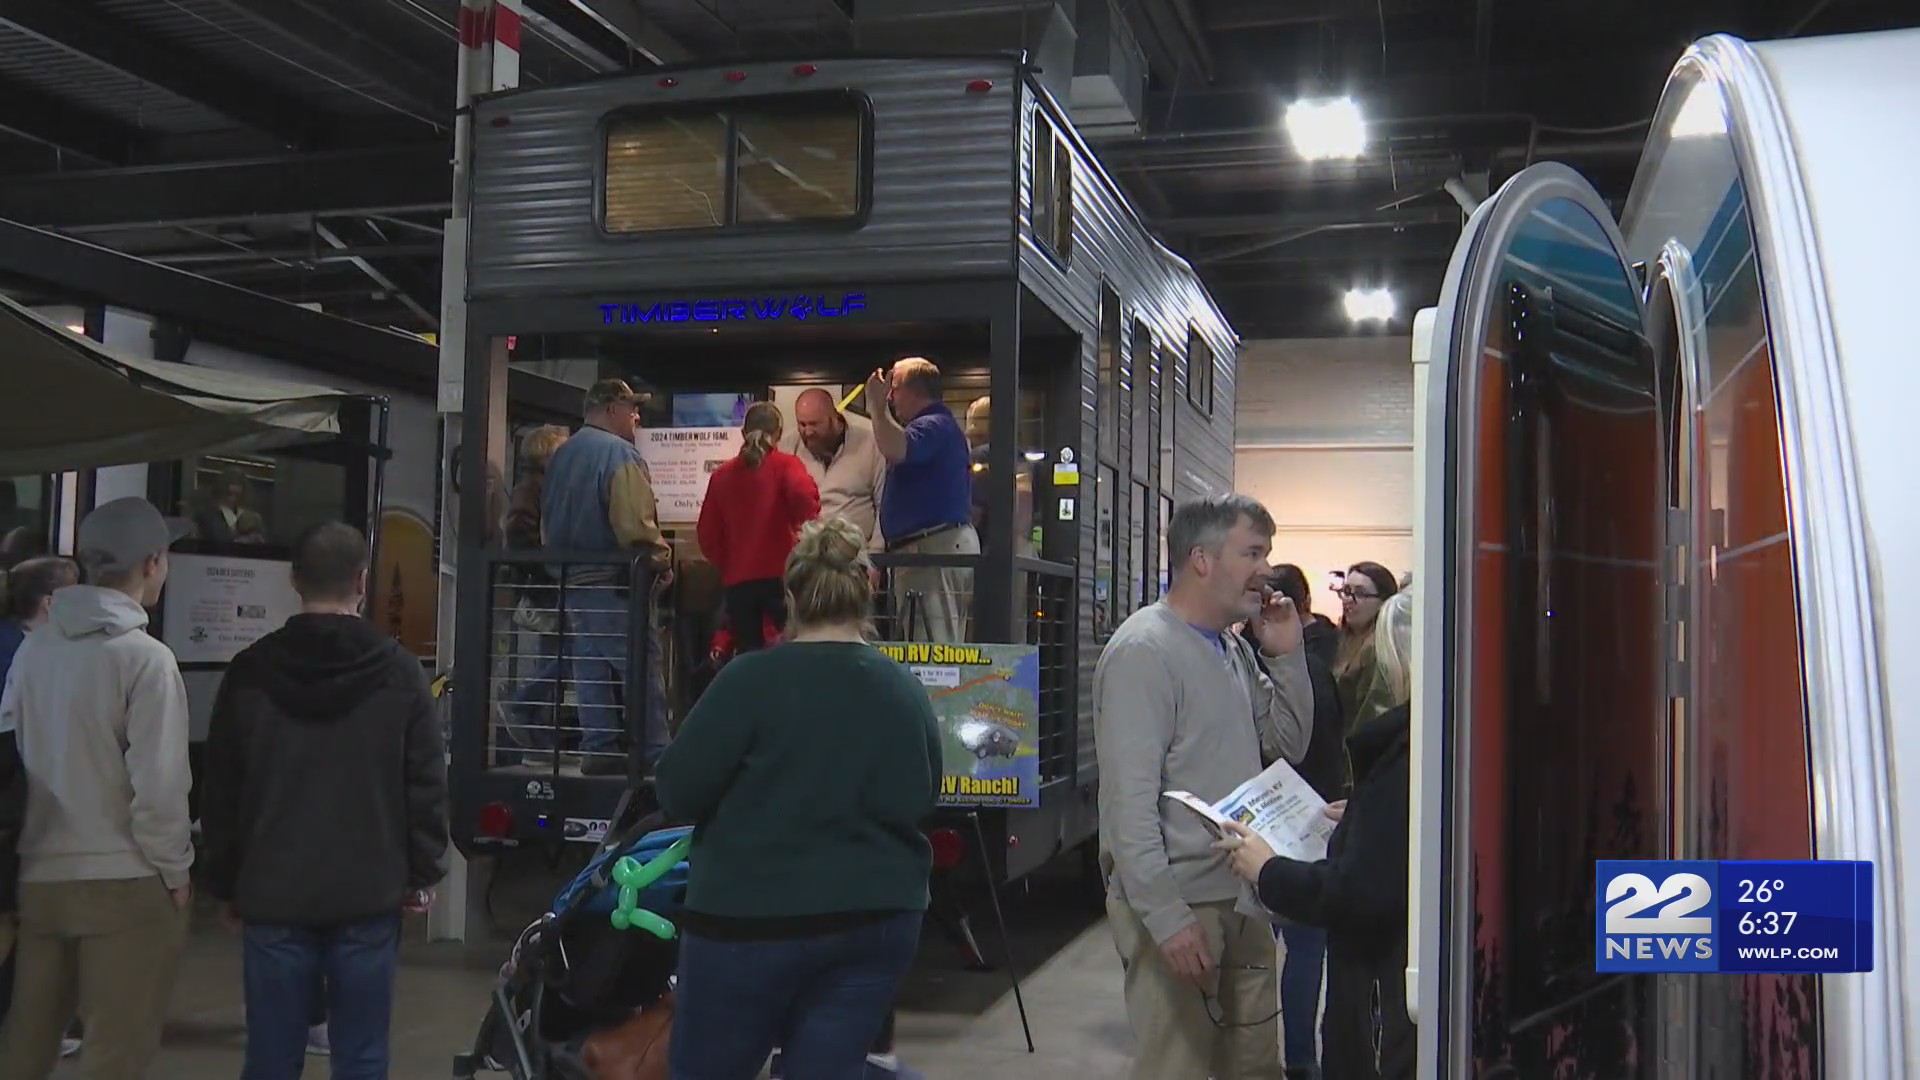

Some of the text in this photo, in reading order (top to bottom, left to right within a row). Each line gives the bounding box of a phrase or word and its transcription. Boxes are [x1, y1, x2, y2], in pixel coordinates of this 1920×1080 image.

[651, 432, 668, 441] 2024
[669, 431, 711, 441] TIMBERWOLF
[674, 500, 694, 508] Only
[879, 644, 992, 665] om RV Show...
[961, 775, 1018, 795] Ranch!
